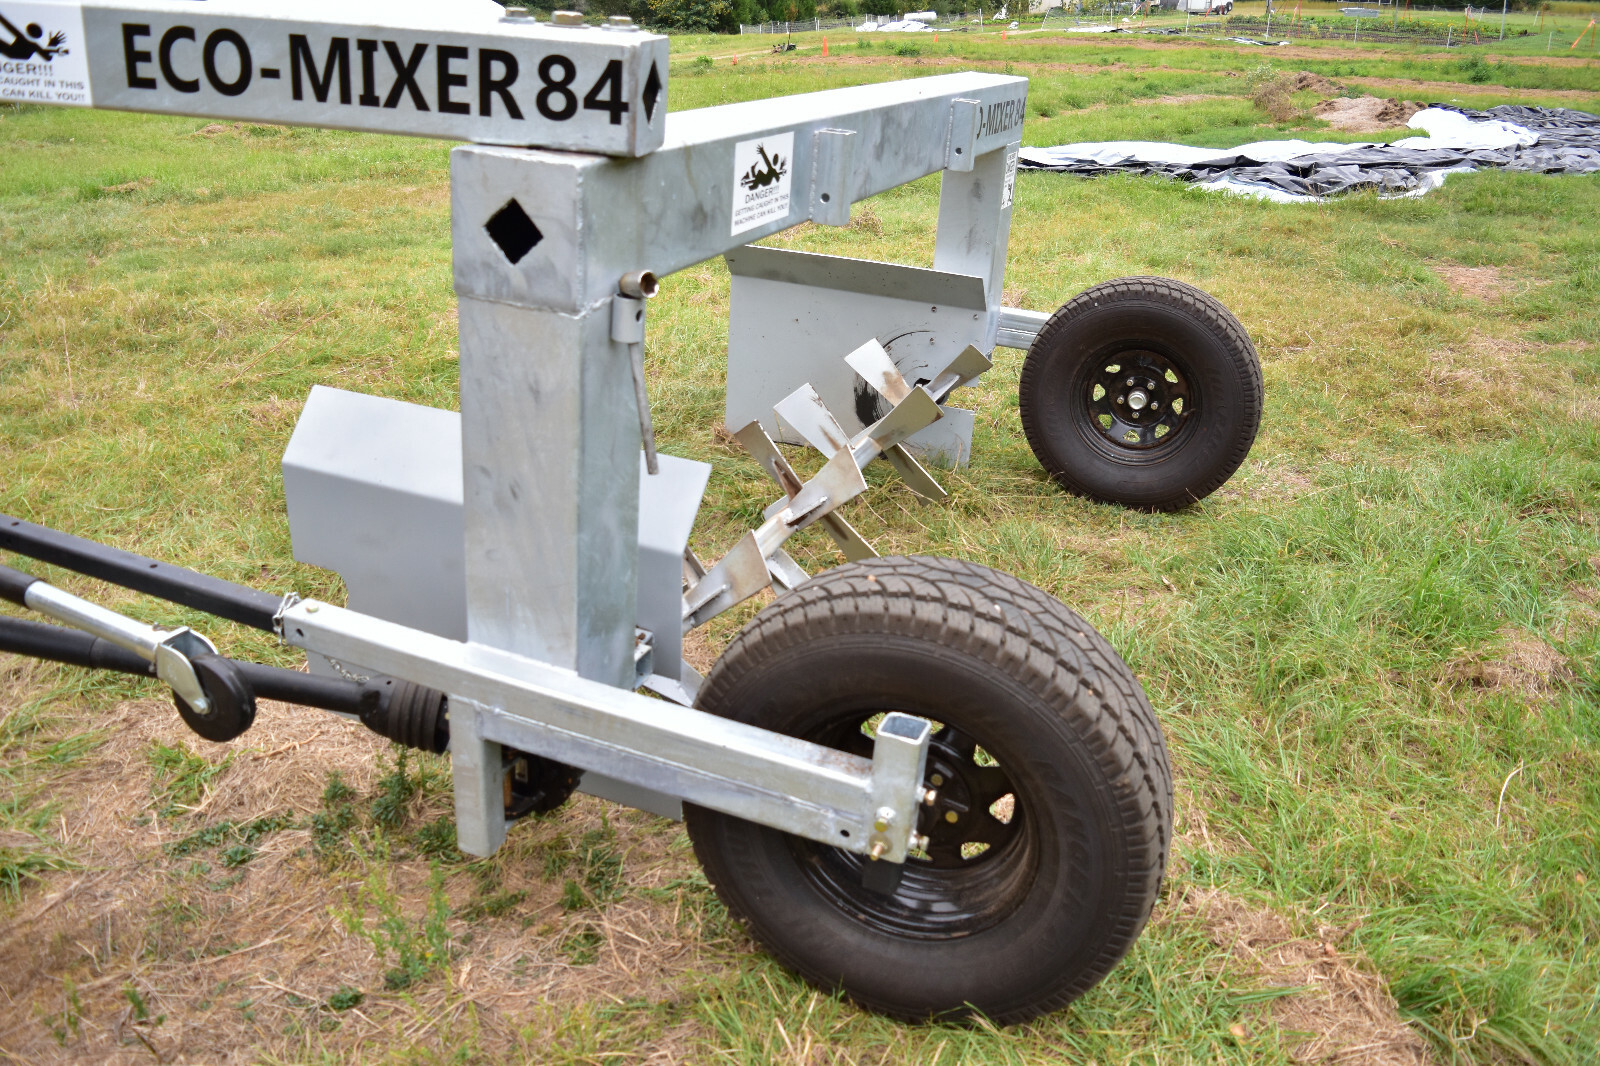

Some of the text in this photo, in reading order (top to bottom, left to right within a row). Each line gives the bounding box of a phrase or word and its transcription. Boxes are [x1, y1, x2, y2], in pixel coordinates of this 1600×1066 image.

[0, 61, 53, 77] GER!!!
[121, 22, 630, 126] ECO-MIXER 84
[44, 79, 56, 88] IN
[58, 80, 85, 90] THIS
[2, 87, 25, 97] CAN
[28, 90, 53, 100] KILL
